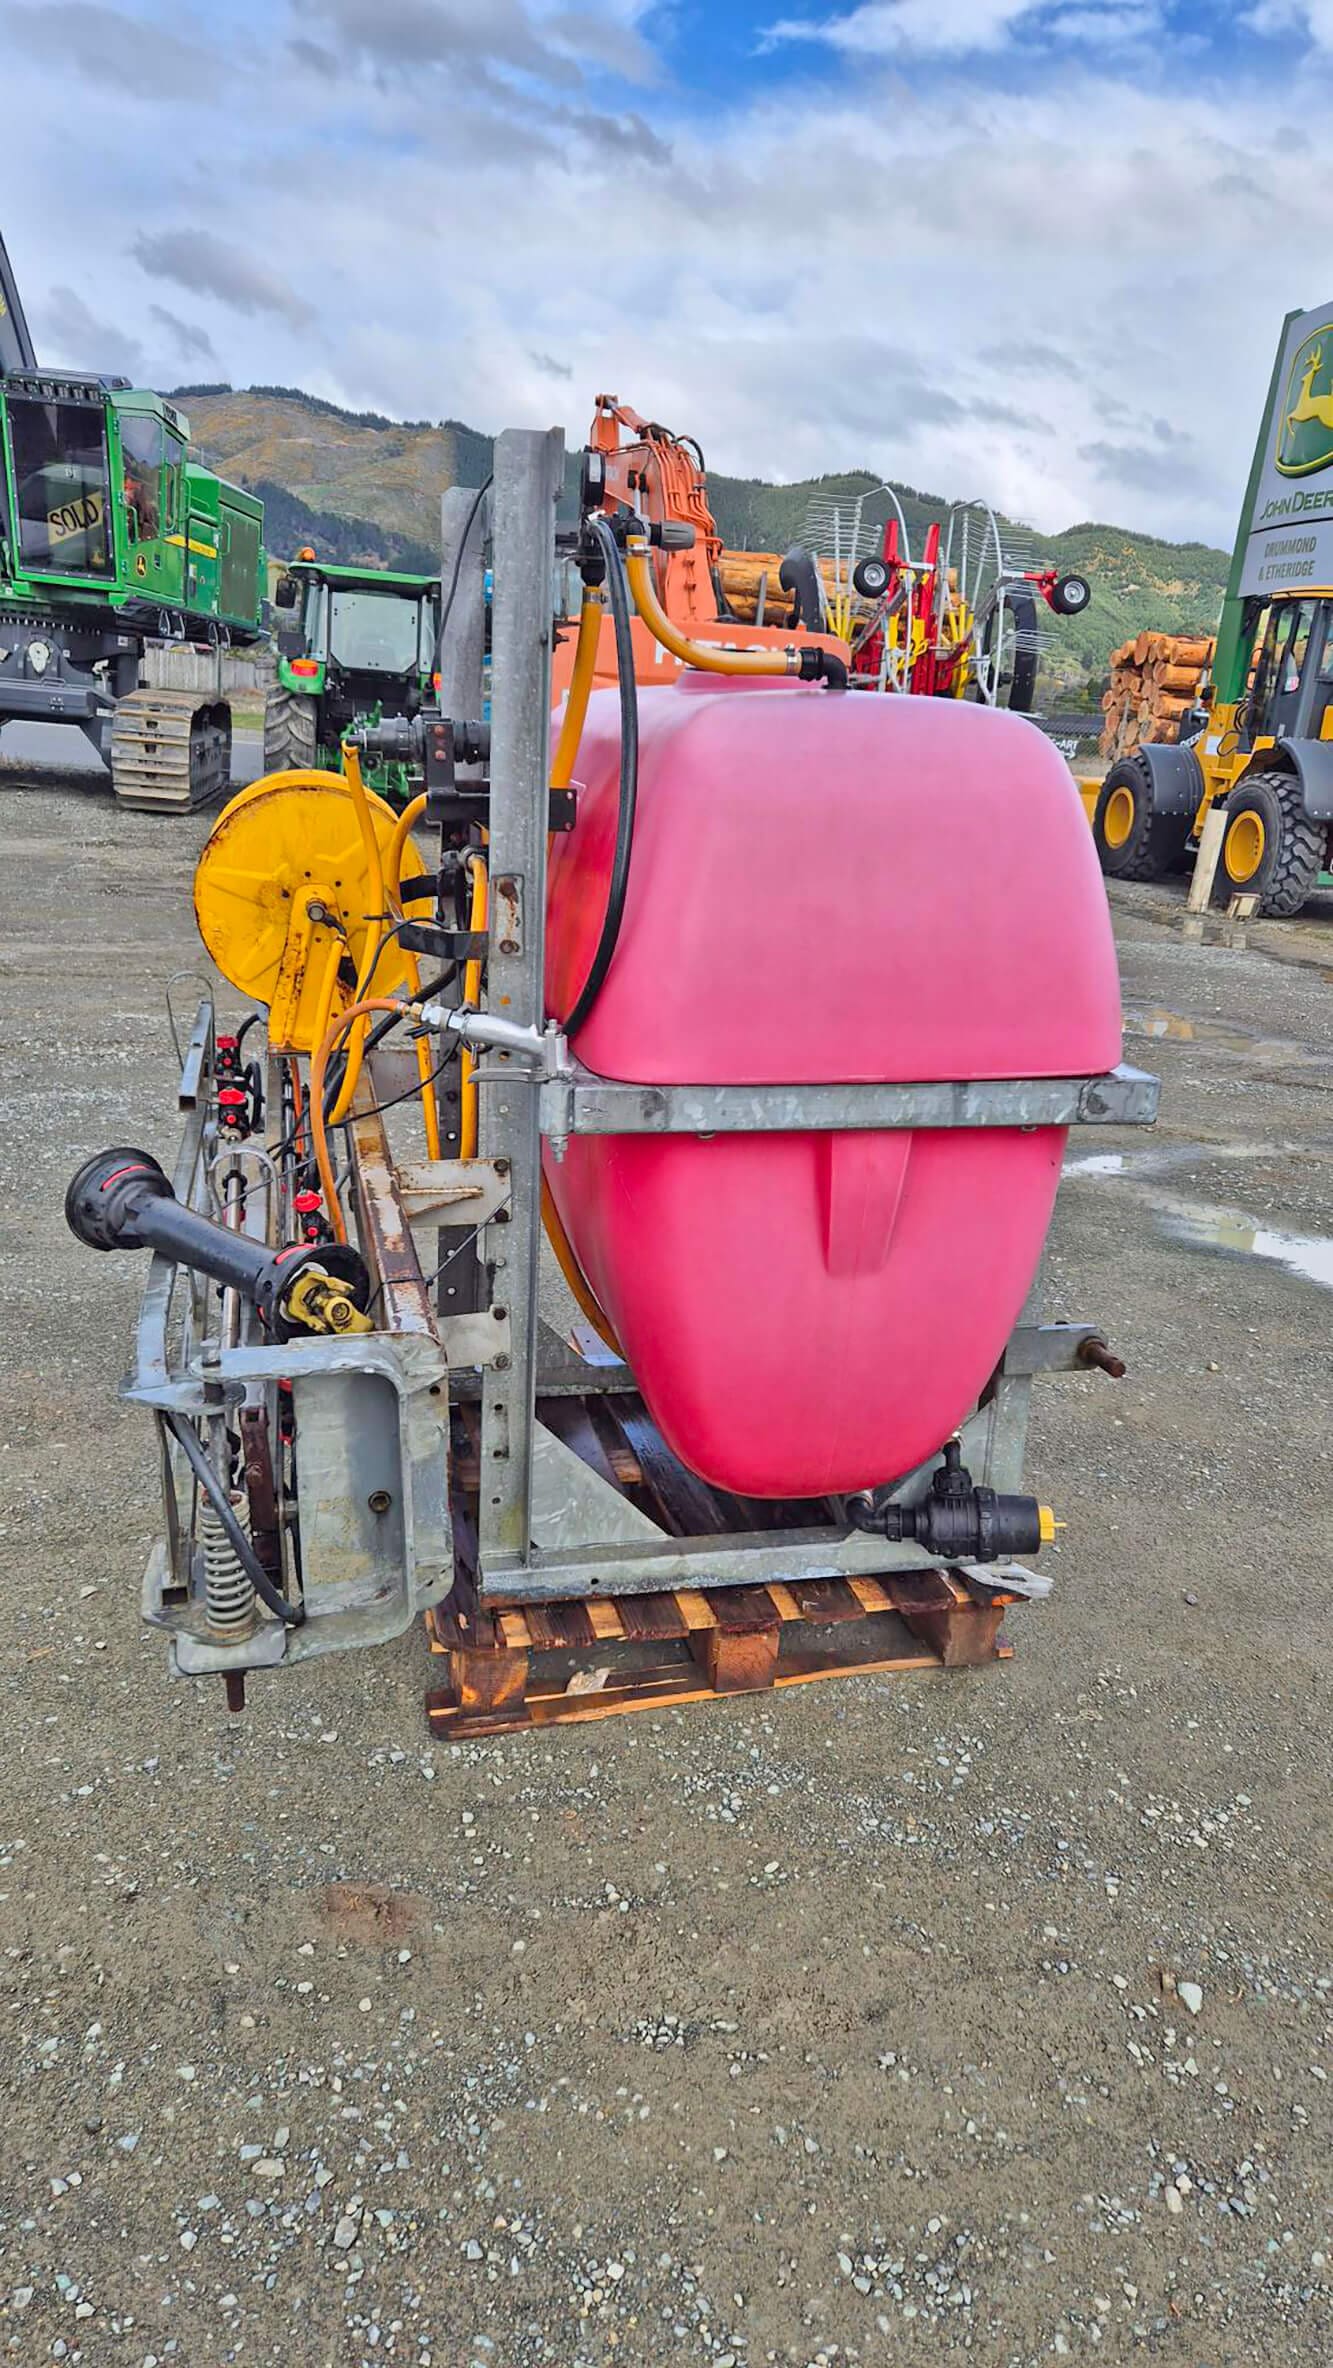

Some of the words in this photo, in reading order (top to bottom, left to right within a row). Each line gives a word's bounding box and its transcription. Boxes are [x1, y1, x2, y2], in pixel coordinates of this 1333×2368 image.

[50, 498, 99, 536] SOLD
[1260, 498, 1292, 520] JOHN
[1264, 536, 1317, 559] DRUMMOND
[1266, 560, 1316, 580] ETHERIDGE
